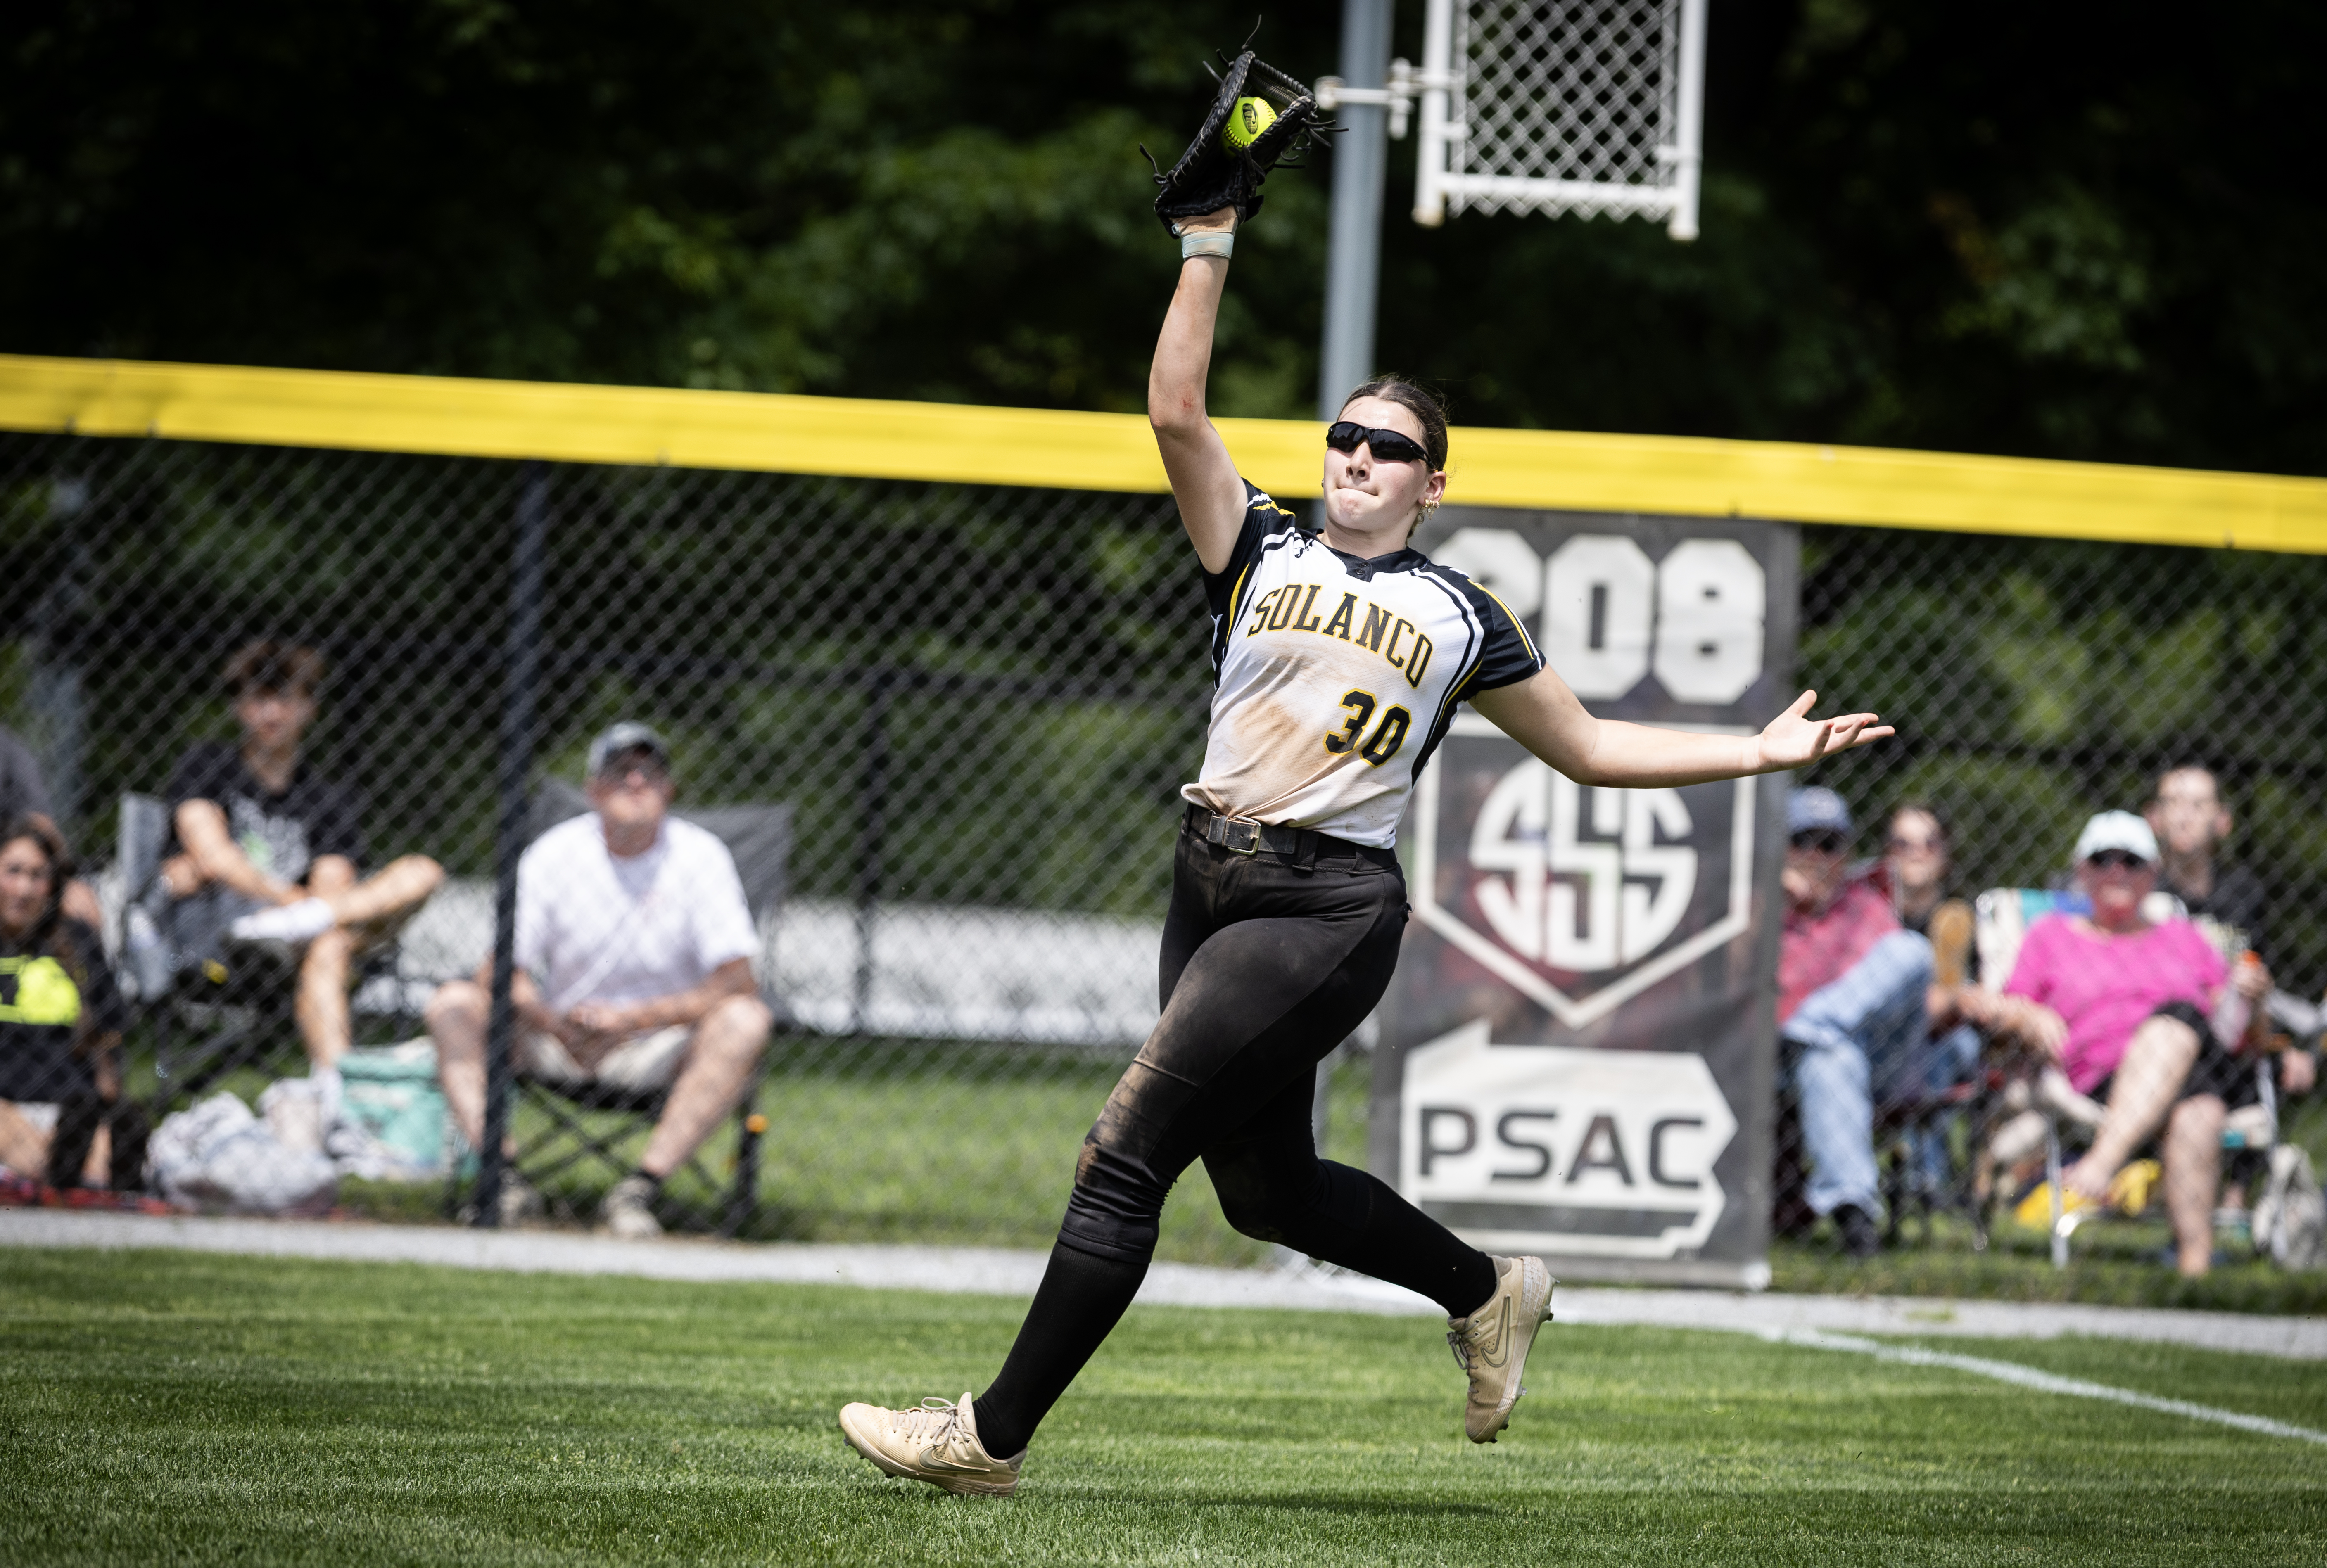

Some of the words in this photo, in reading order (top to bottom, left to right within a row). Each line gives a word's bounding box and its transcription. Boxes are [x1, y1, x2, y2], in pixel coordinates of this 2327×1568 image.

[1246, 584, 1433, 689] SOLANCO
[1324, 688, 1411, 769] 30
[1420, 1107, 1703, 1188] PSAC
